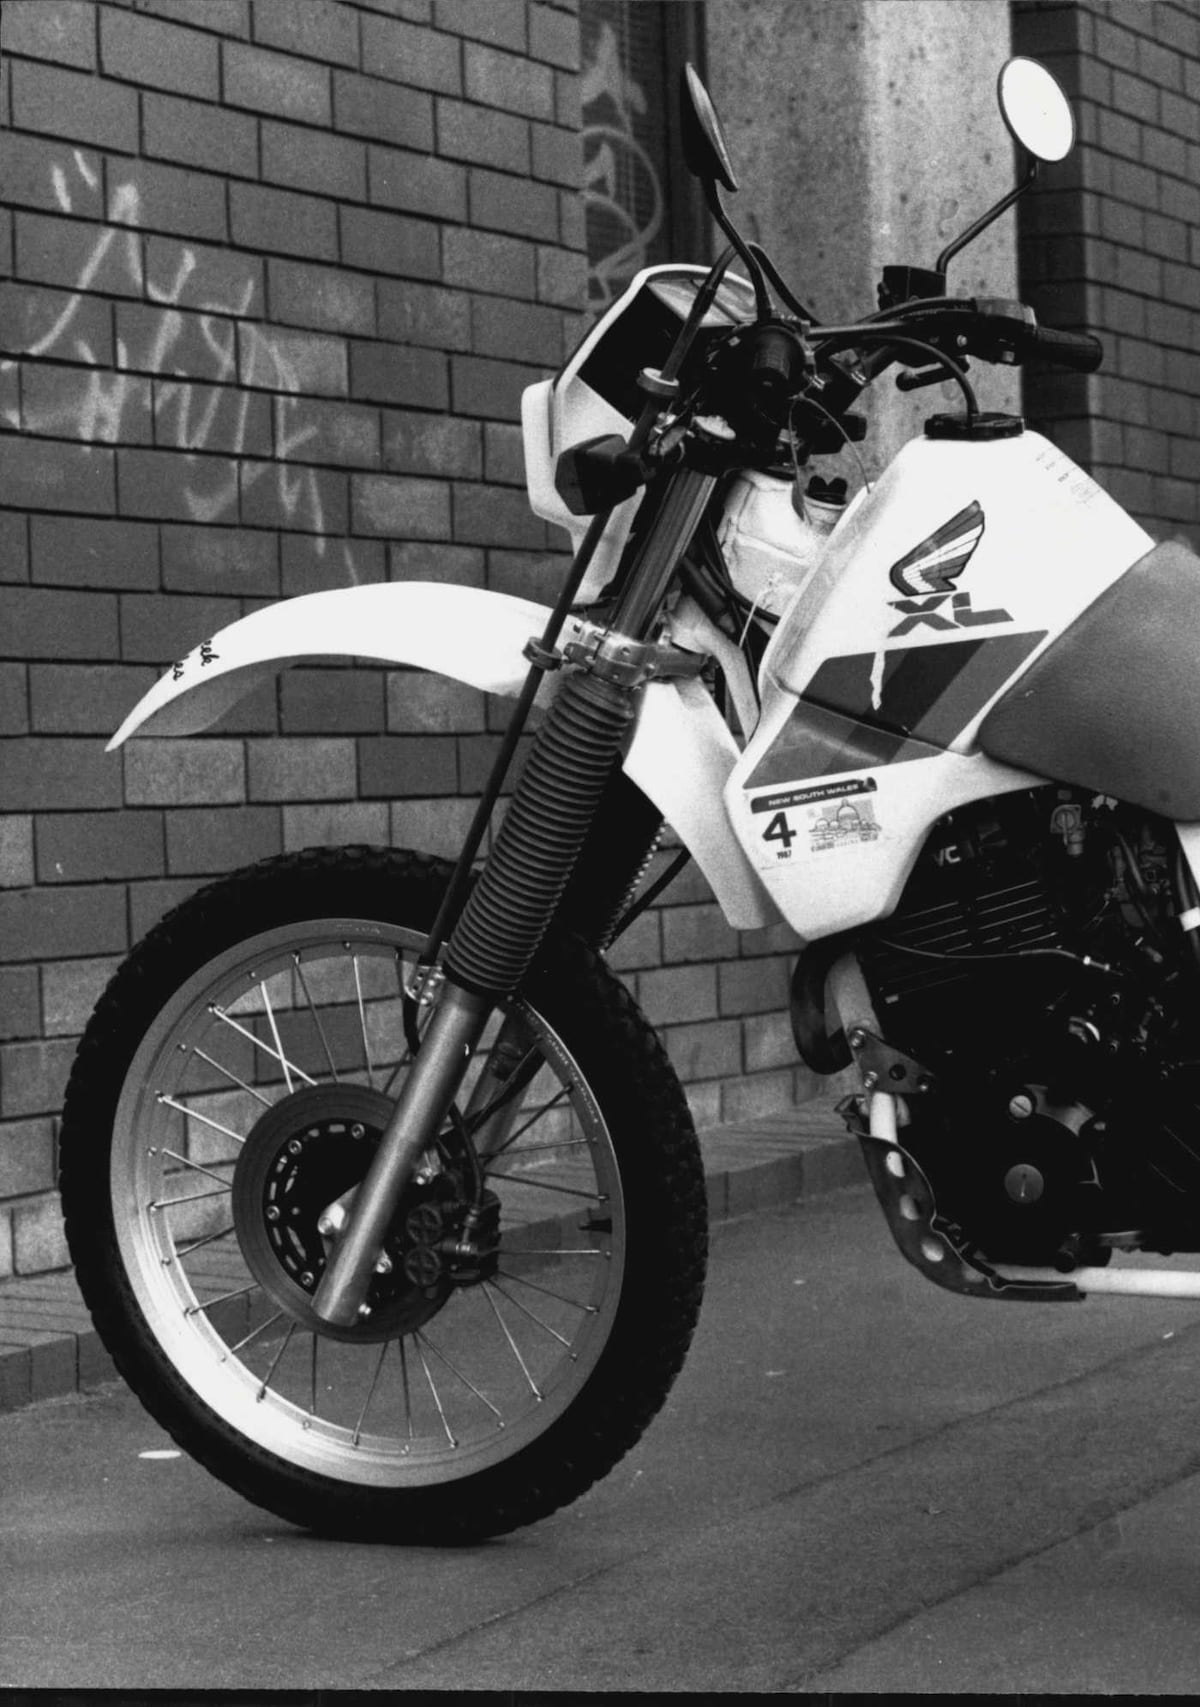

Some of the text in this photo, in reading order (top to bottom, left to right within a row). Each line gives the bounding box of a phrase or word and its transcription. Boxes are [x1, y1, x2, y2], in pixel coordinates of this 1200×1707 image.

[886, 592, 1015, 638] XL
[768, 783, 859, 807] NEW SOUTH WALES
[762, 811, 797, 848] 4
